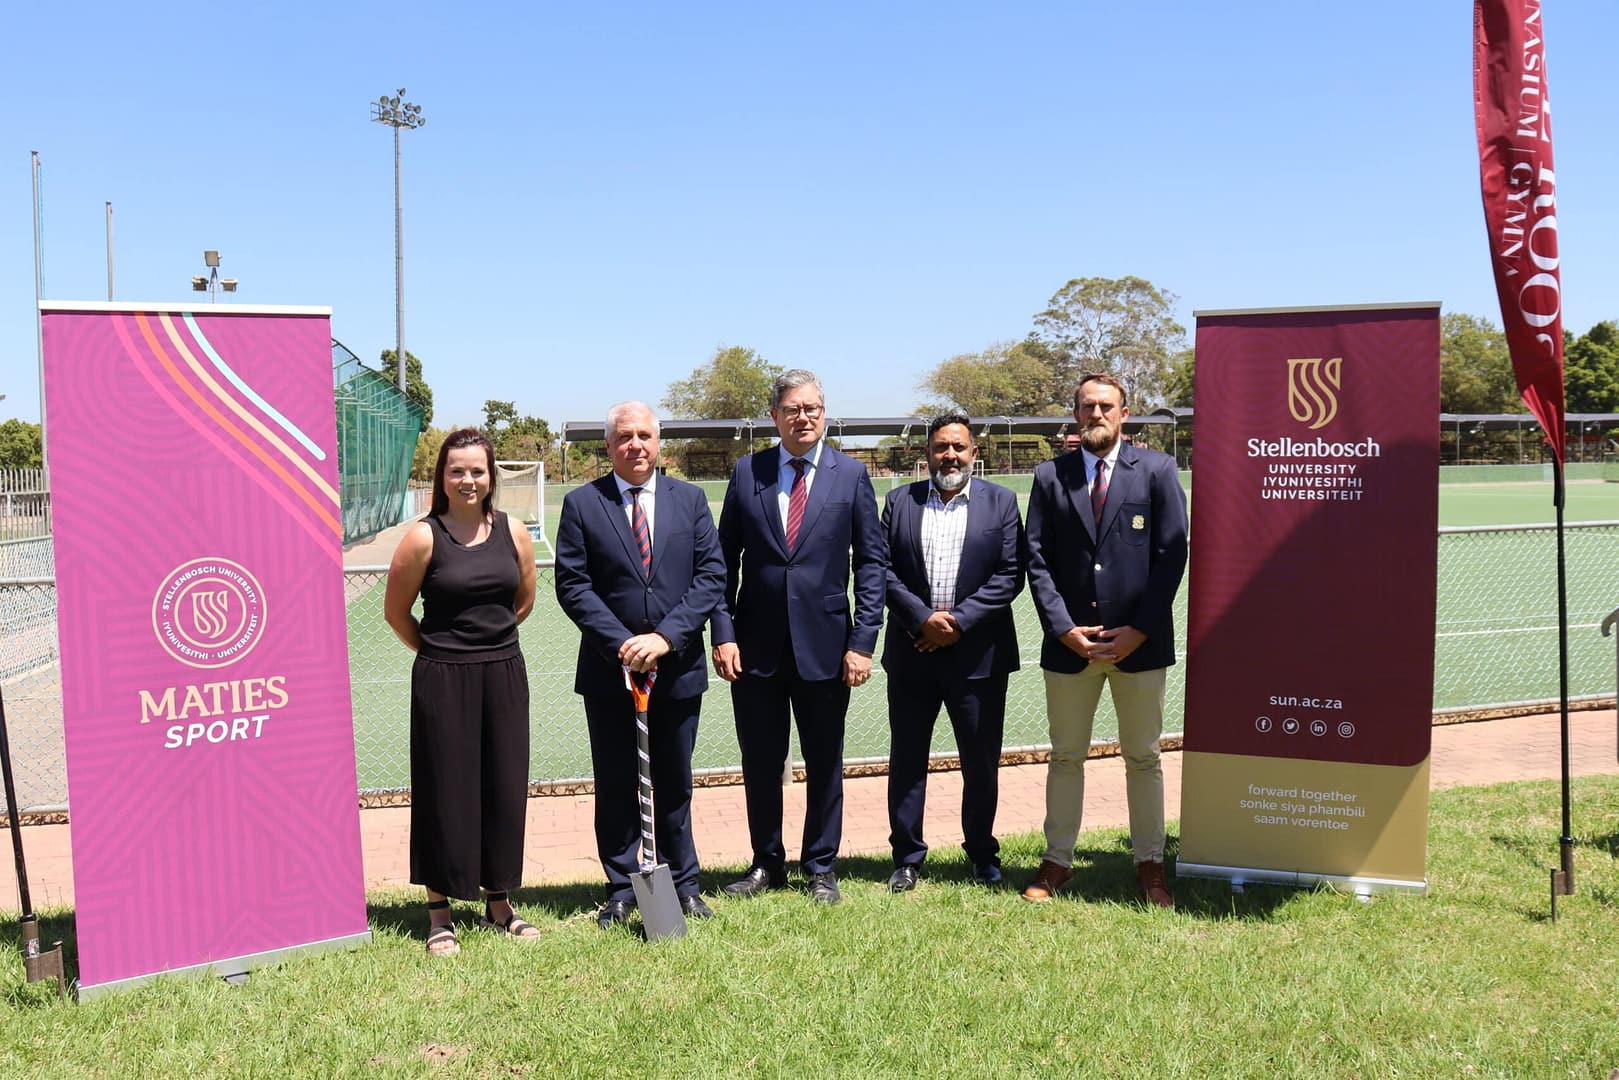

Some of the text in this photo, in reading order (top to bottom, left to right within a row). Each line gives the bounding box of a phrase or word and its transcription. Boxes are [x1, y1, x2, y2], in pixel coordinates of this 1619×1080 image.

[1247, 436, 1381, 458] Stellenbosch
[1268, 463, 1357, 475] UNIVERSITY
[1263, 476, 1363, 488] IYUNIVESITHI
[1261, 489, 1364, 501] UNIVERSITEIT
[162, 566, 257, 610] STELLENBOSCH UNIVERSITY
[162, 613, 258, 660] IYUNIVESITHI UNIVERSITEIT
[138, 676, 289, 724] MATIES
[1269, 694, 1343, 710] sun.ac.za
[164, 715, 271, 749] SPORT
[1248, 783, 1358, 803] forward together
[1239, 798, 1366, 818] sonke siya phambili
[1254, 813, 1350, 831] saam vorentoe
